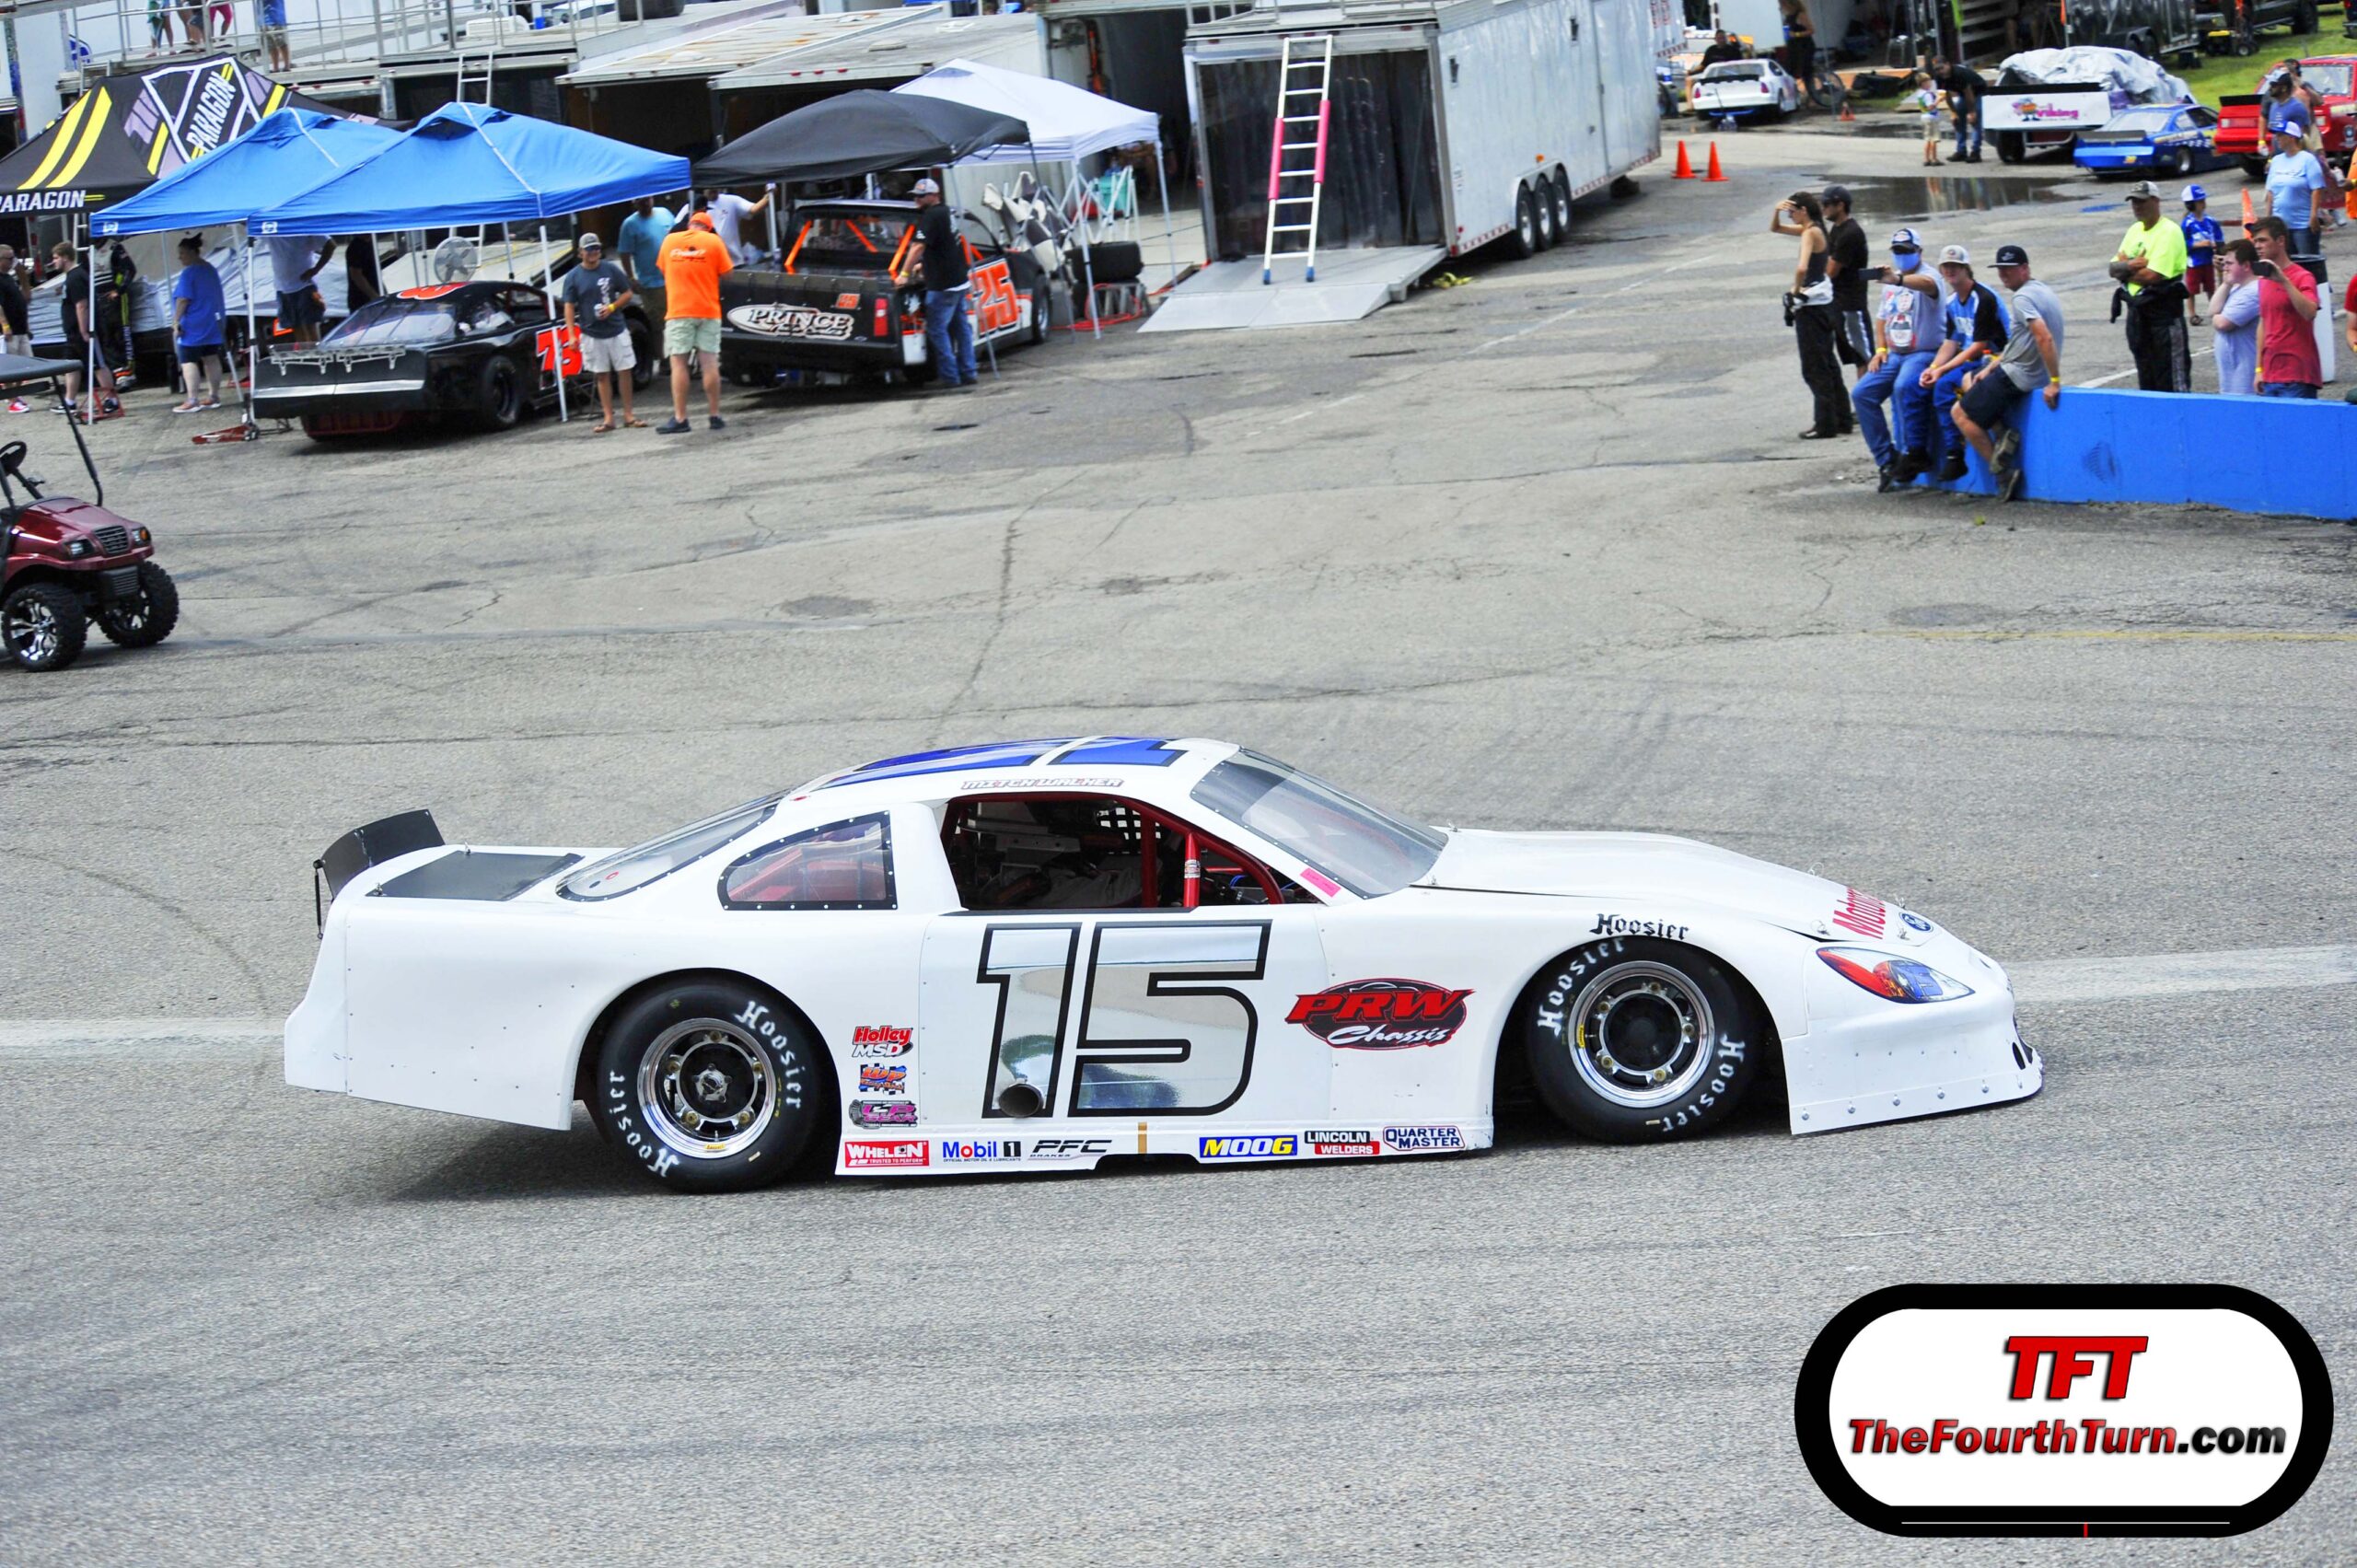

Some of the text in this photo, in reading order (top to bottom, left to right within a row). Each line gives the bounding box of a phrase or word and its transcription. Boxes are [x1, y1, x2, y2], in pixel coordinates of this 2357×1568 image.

[186, 71, 237, 153] PARAGON
[0, 190, 87, 213] ARAGON
[748, 308, 851, 330] PRINCE
[1589, 913, 1689, 940] Hoosier
[1538, 936, 1626, 1038] Hoosier
[1285, 989, 1476, 1025] PRW
[976, 919, 1272, 1119] 15
[853, 1026, 912, 1046] Holley
[1327, 1025, 1452, 1045] Chassis
[734, 1000, 805, 1109] Hoosier
[852, 1043, 903, 1058] MSD
[1662, 1033, 1746, 1132] Hoosier
[609, 1069, 681, 1178] Hoosier
[1307, 1132, 1367, 1144] LINCOLN
[1385, 1128, 1457, 1143] QUARTER
[1399, 1137, 1460, 1148] MASTER
[846, 1142, 923, 1158] WHELEN
[942, 1141, 1018, 1158] Mobil 1
[1032, 1140, 1112, 1153] PFC
[1203, 1137, 1294, 1156] MOOG
[1320, 1144, 1374, 1155] WELDERS
